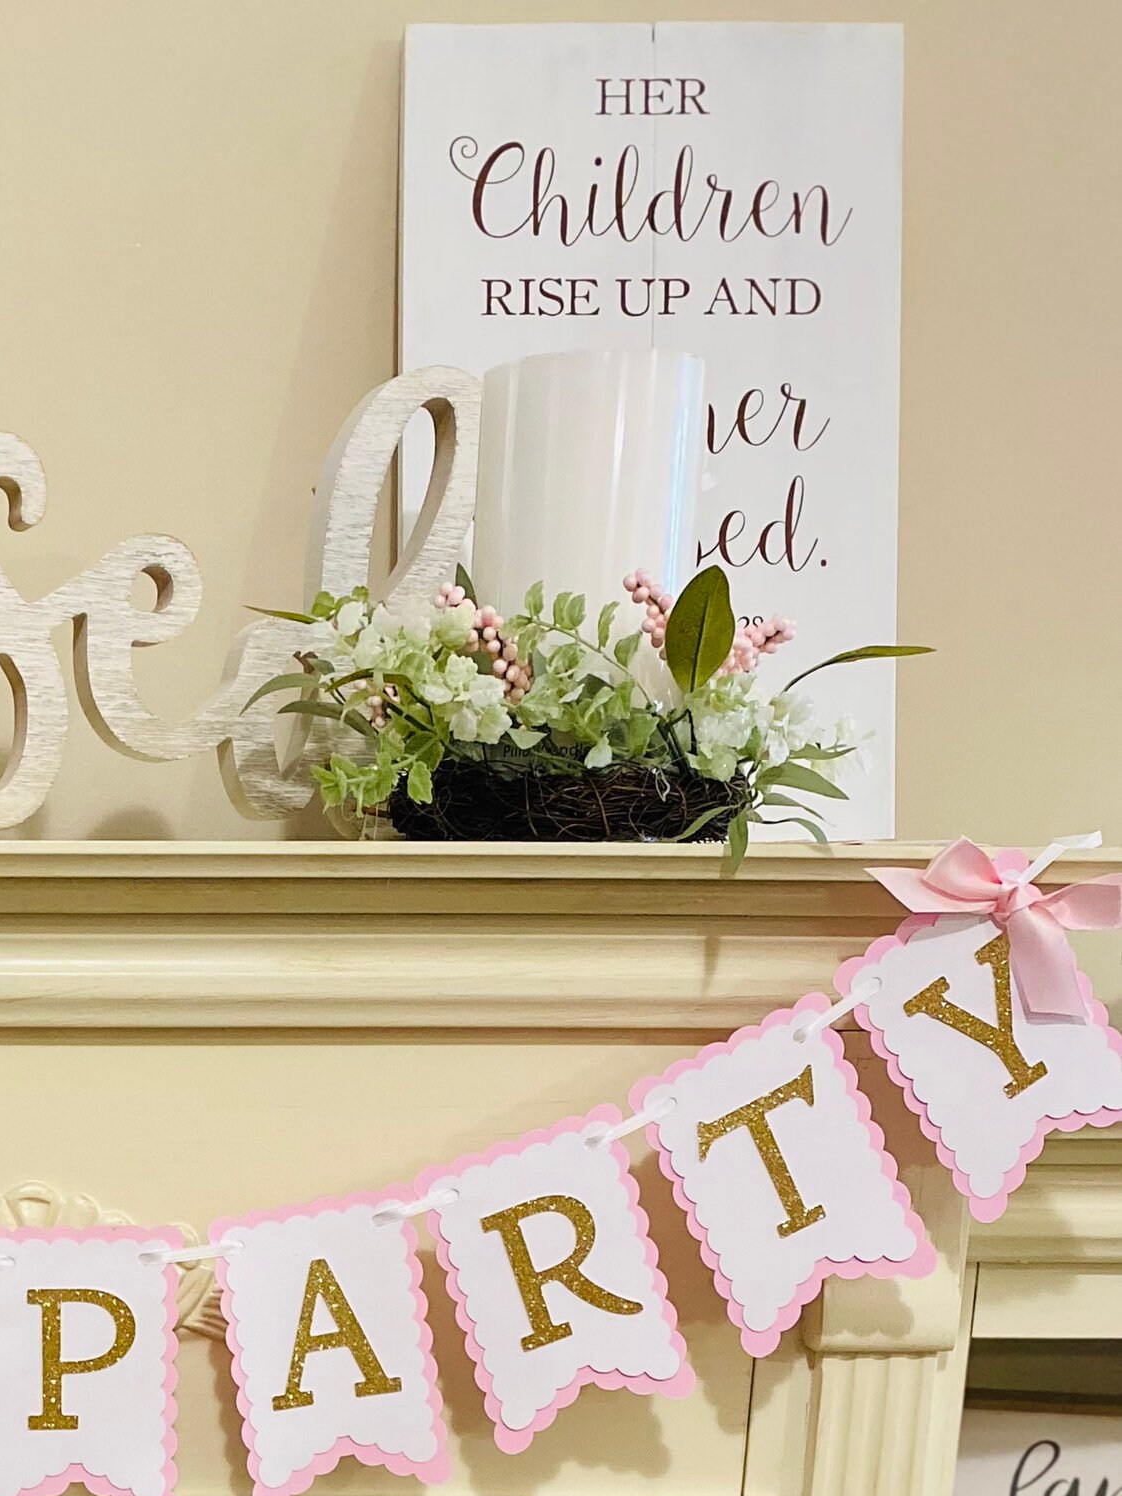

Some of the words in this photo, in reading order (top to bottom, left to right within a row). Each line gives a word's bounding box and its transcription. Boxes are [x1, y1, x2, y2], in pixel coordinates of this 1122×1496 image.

[595, 78, 710, 115] HER
[449, 136, 854, 247] Children
[480, 278, 600, 317] RISE
[615, 278, 691, 317] UP
[704, 277, 822, 316] AND
[695, 475, 828, 572] ed.
[25, 931, 1049, 1432] PARTY
